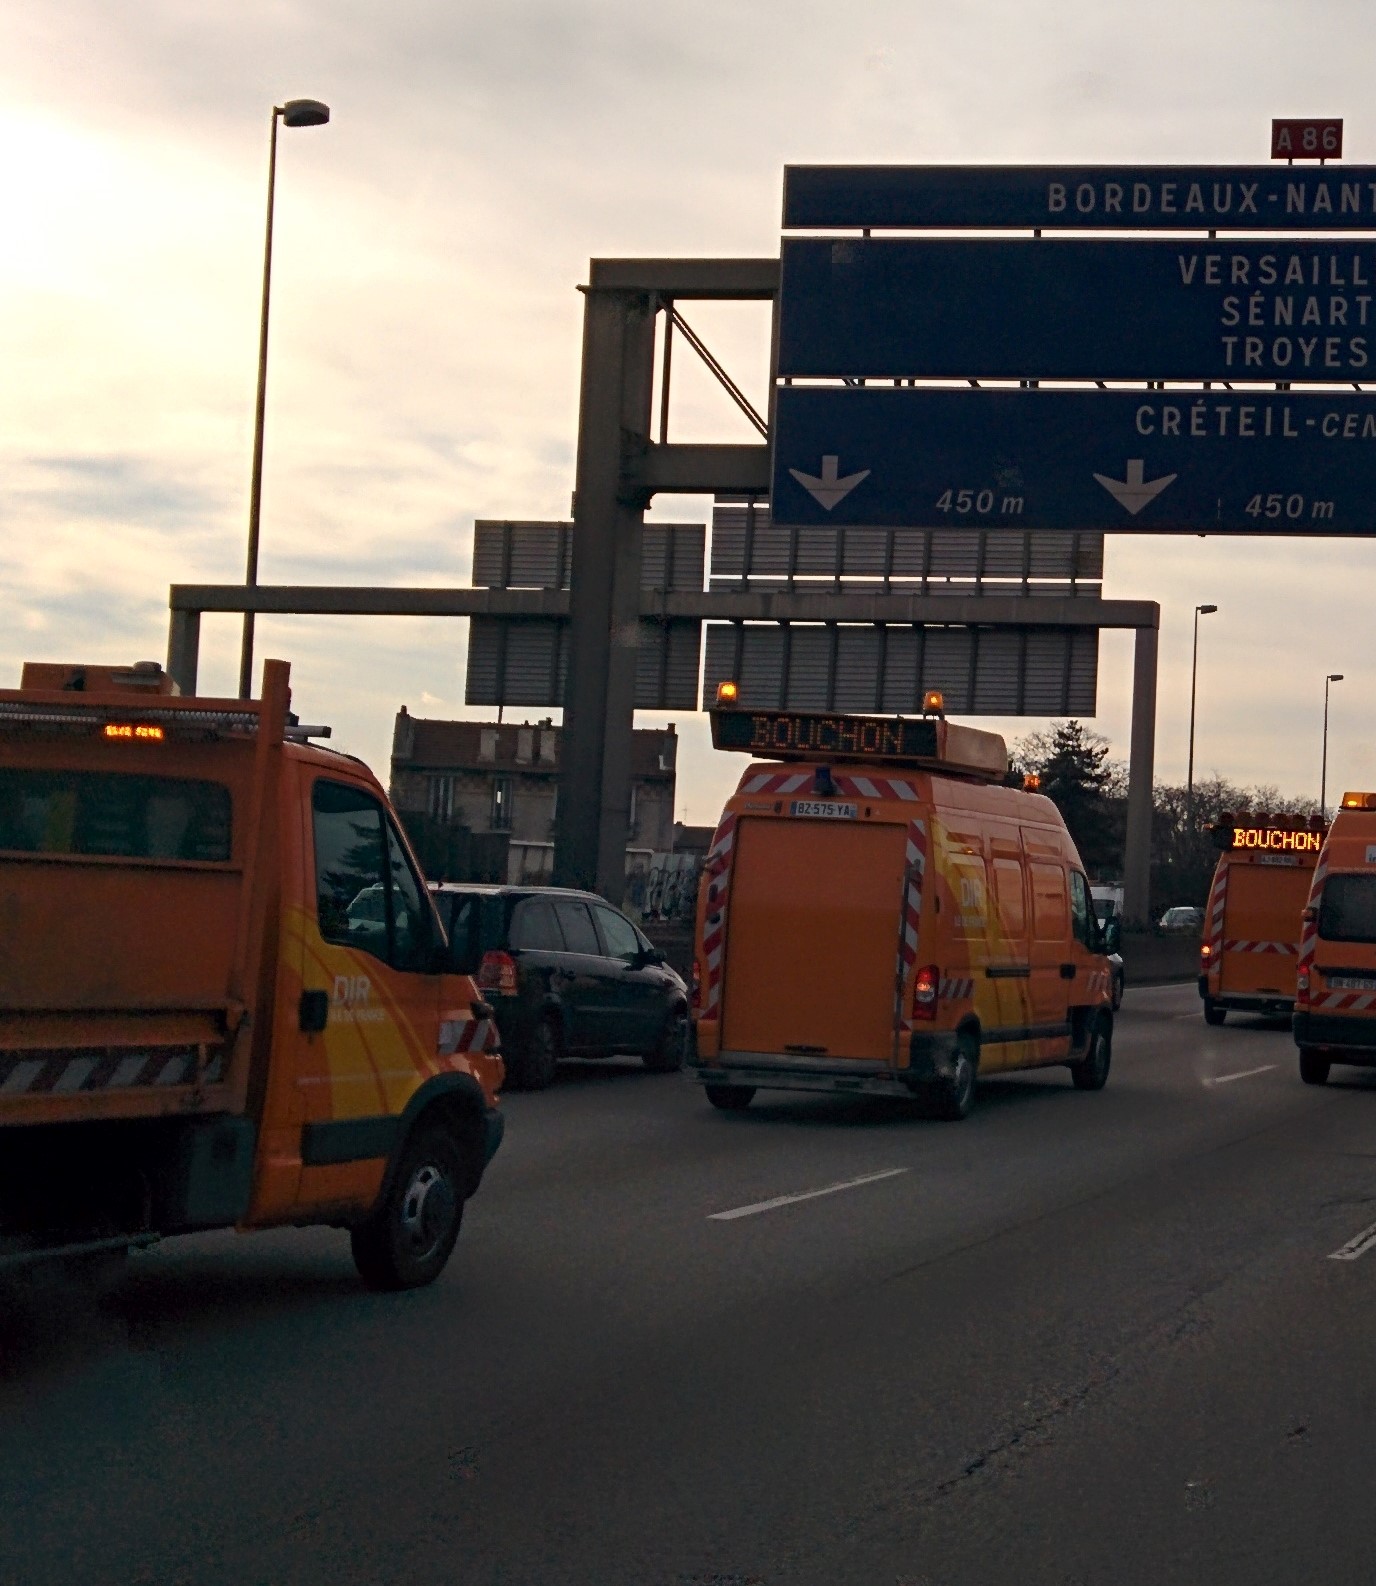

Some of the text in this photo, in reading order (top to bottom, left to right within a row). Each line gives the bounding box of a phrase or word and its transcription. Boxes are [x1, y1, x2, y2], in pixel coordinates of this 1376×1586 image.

[1277, 126, 1337, 151] A 86
[1221, 291, 1372, 327] SÉNART
[1222, 336, 1369, 368] TROYES
[935, 488, 1024, 515] 450 m
[1244, 493, 1335, 519] 450 m
[750, 715, 904, 753] BOUCHON
[1232, 827, 1321, 851] BOUCHON
[332, 974, 372, 1004] DIR
